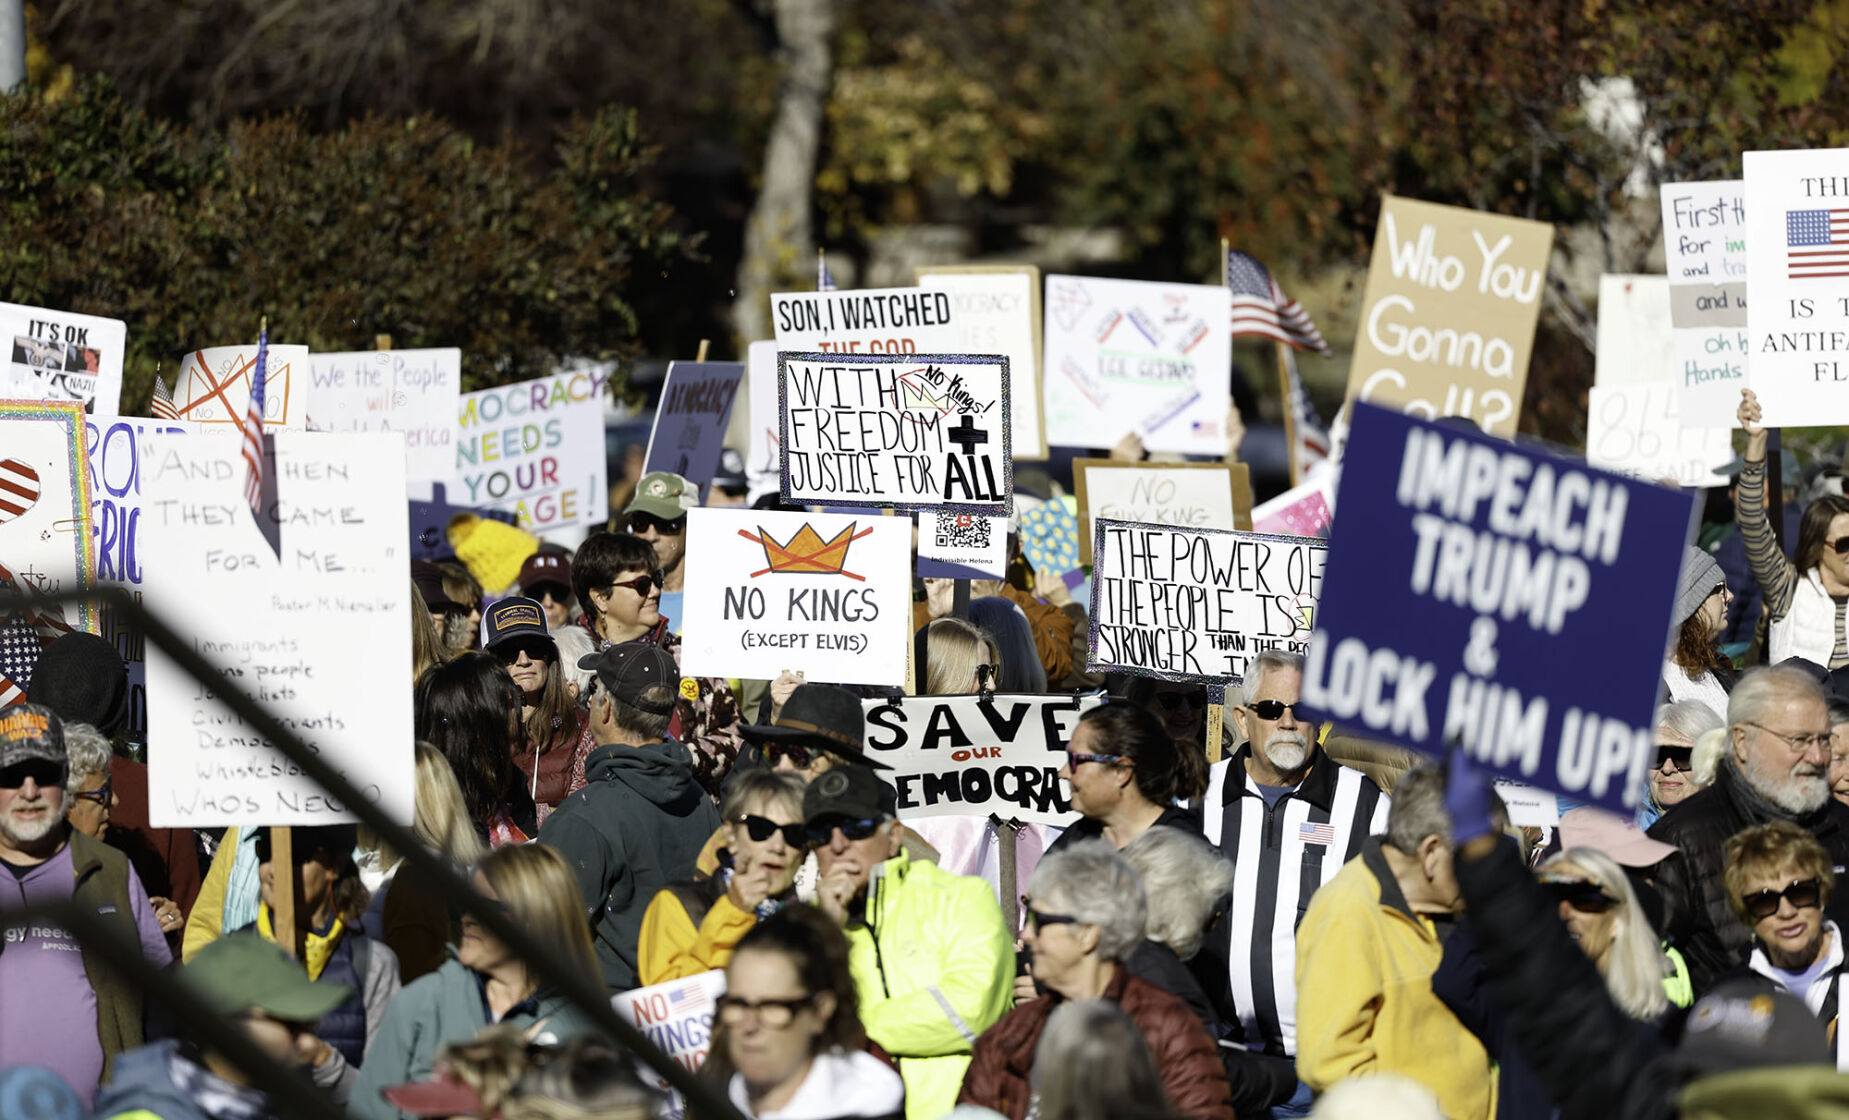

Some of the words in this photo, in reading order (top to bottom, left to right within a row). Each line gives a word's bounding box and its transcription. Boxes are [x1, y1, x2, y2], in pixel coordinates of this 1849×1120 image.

[1673, 196, 1727, 229] First
[1385, 211, 1464, 291] Who
[1472, 228, 1541, 304] You
[1679, 235, 1711, 256] for
[1683, 262, 1709, 277] and
[840, 292, 951, 330] WATCHED
[1696, 291, 1727, 311] and
[1790, 299, 1814, 319] IS
[29, 319, 60, 341] IT'S
[65, 326, 88, 345] OK
[1367, 294, 1514, 379] Gonna
[311, 363, 345, 388] We
[355, 362, 382, 386] the
[392, 356, 448, 393] People
[789, 364, 900, 409] WITH
[924, 365, 945, 386] NO
[947, 373, 996, 415] Kings!
[1685, 360, 1742, 387] Hands
[456, 418, 562, 470] NEEDS
[791, 408, 943, 452] FREEDOM
[263, 450, 349, 481] THEN
[463, 456, 560, 502] YOUR
[788, 450, 885, 495] JUSTICE
[894, 454, 940, 494] FOR
[944, 453, 1005, 501] ALL
[1131, 476, 1175, 505] NO
[1396, 426, 1630, 566] IMPEACH
[154, 499, 237, 527] THEY
[268, 502, 365, 525] CAME
[206, 550, 261, 573] FOR
[1107, 529, 1168, 582] THE
[1171, 533, 1271, 593] POWER
[1287, 546, 1330, 599] OF
[1410, 513, 1592, 635] TRUMP
[724, 586, 765, 620] NO
[788, 588, 879, 622] KINGS
[1104, 577, 1148, 627] THE
[1149, 581, 1240, 634] PEOPLE
[1256, 594, 1296, 638] IS
[193, 638, 298, 663] Immigrants
[741, 630, 809, 651] (EXCEPT
[817, 633, 868, 655] ELVIS)
[1099, 624, 1203, 675] STRONGER
[1205, 634, 1245, 651] THAN
[1249, 637, 1283, 653] THE
[1463, 614, 1498, 678] &
[254, 660, 314, 681] people
[0, 712, 49, 736] HARRIS
[8, 728, 44, 742] WALZ
[866, 702, 1081, 751] SAVE
[1303, 628, 1437, 742] LOCK
[1442, 672, 1548, 777] HIM
[1556, 706, 1652, 808] UP!
[951, 747, 1002, 762] OUR
[632, 993, 668, 1028] NO
